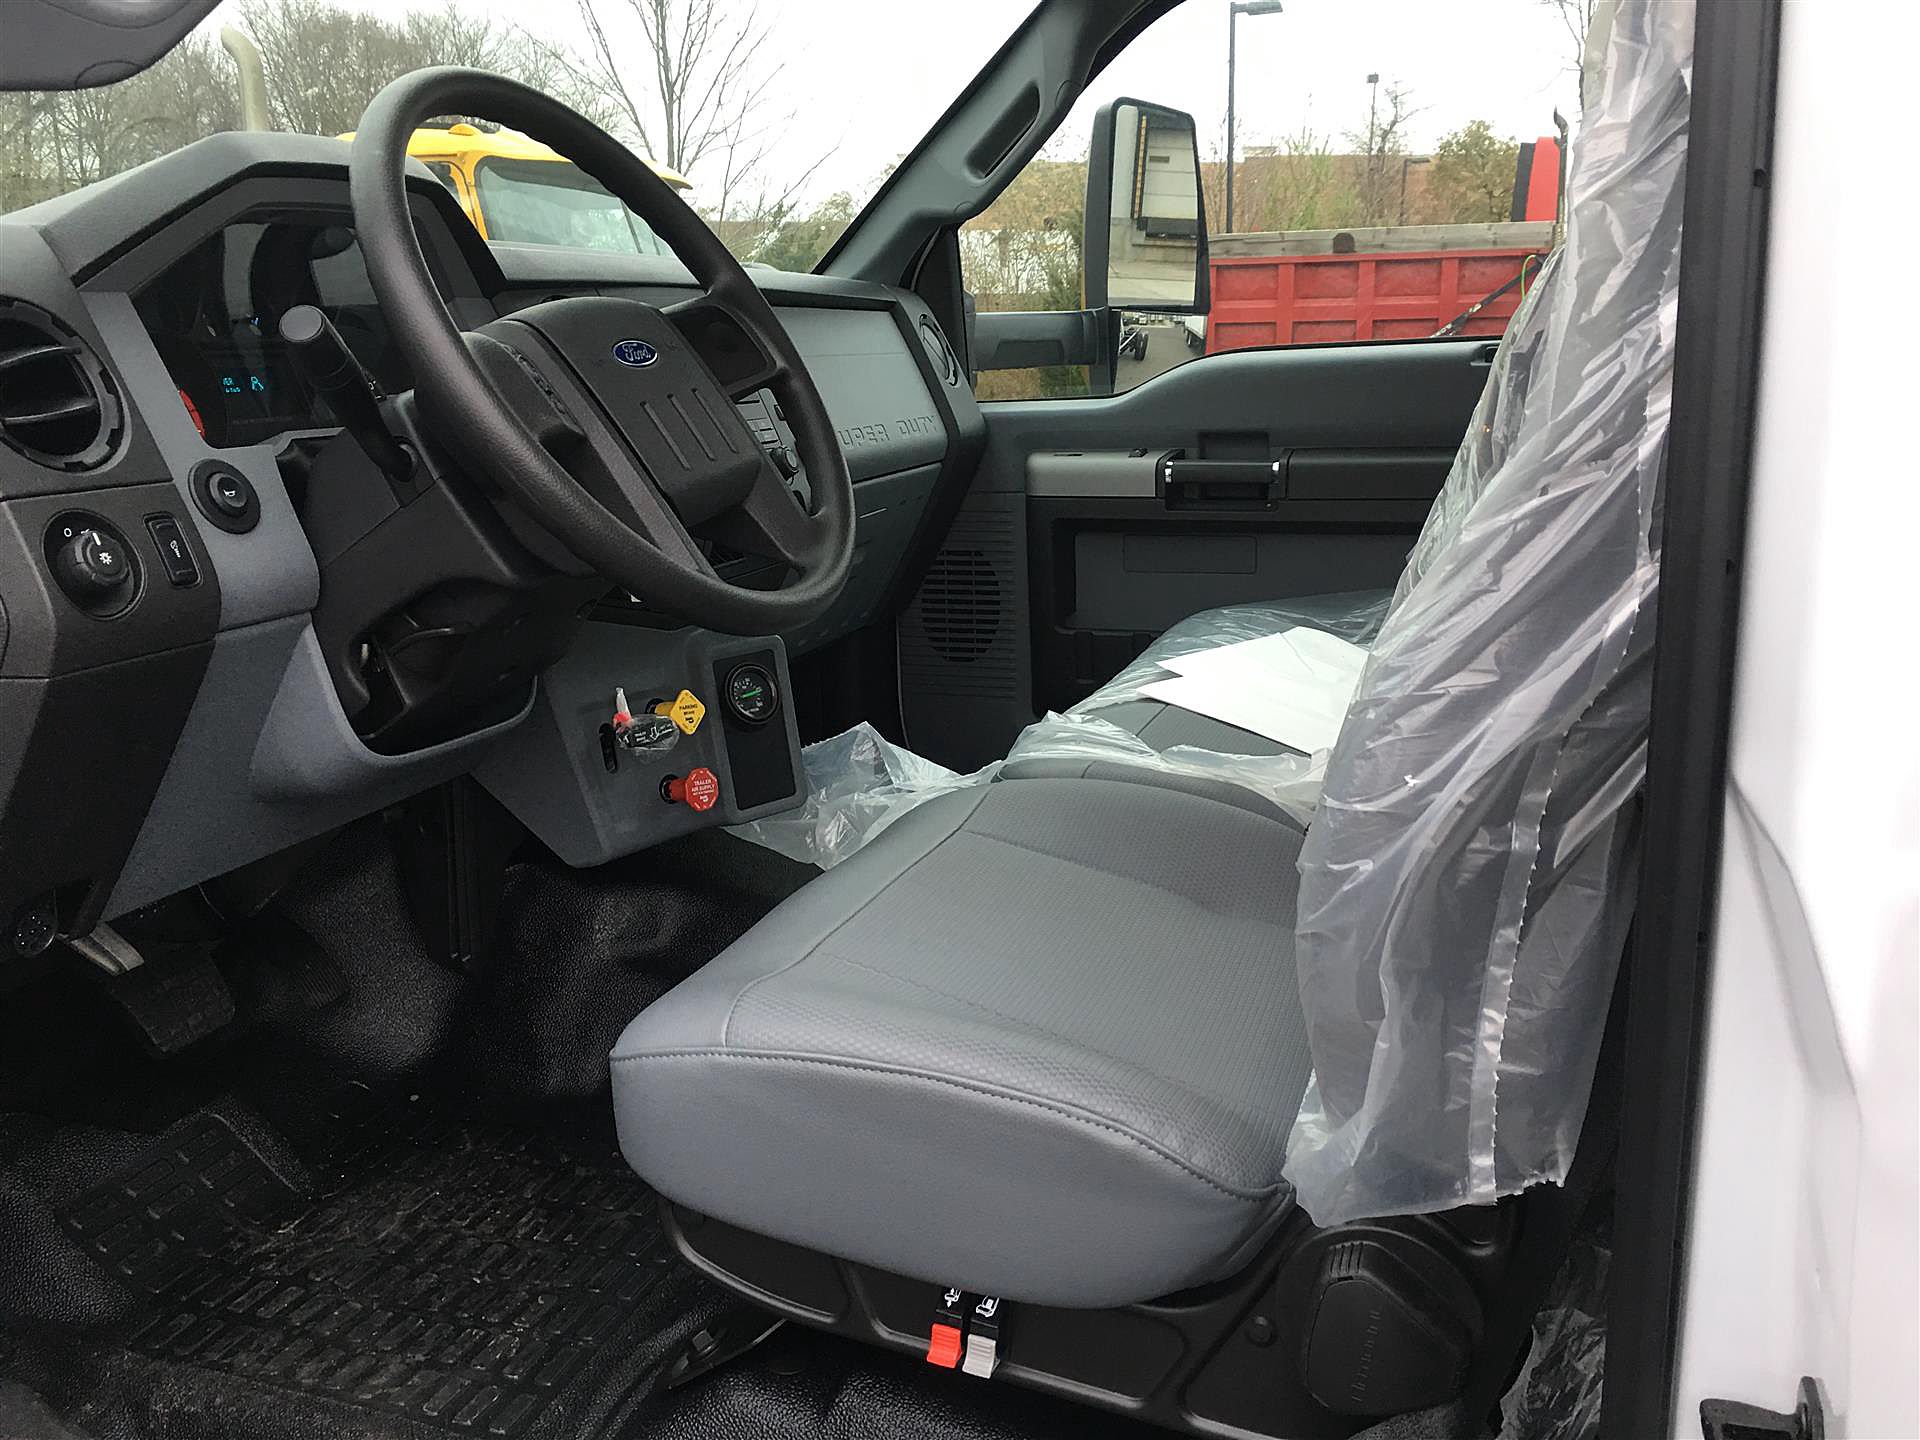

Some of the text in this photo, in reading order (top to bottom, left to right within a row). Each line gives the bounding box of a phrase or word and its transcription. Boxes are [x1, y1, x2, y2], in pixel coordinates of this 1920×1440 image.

[621, 342, 652, 362] Ford
[837, 415, 937, 448] UPER DUTY
